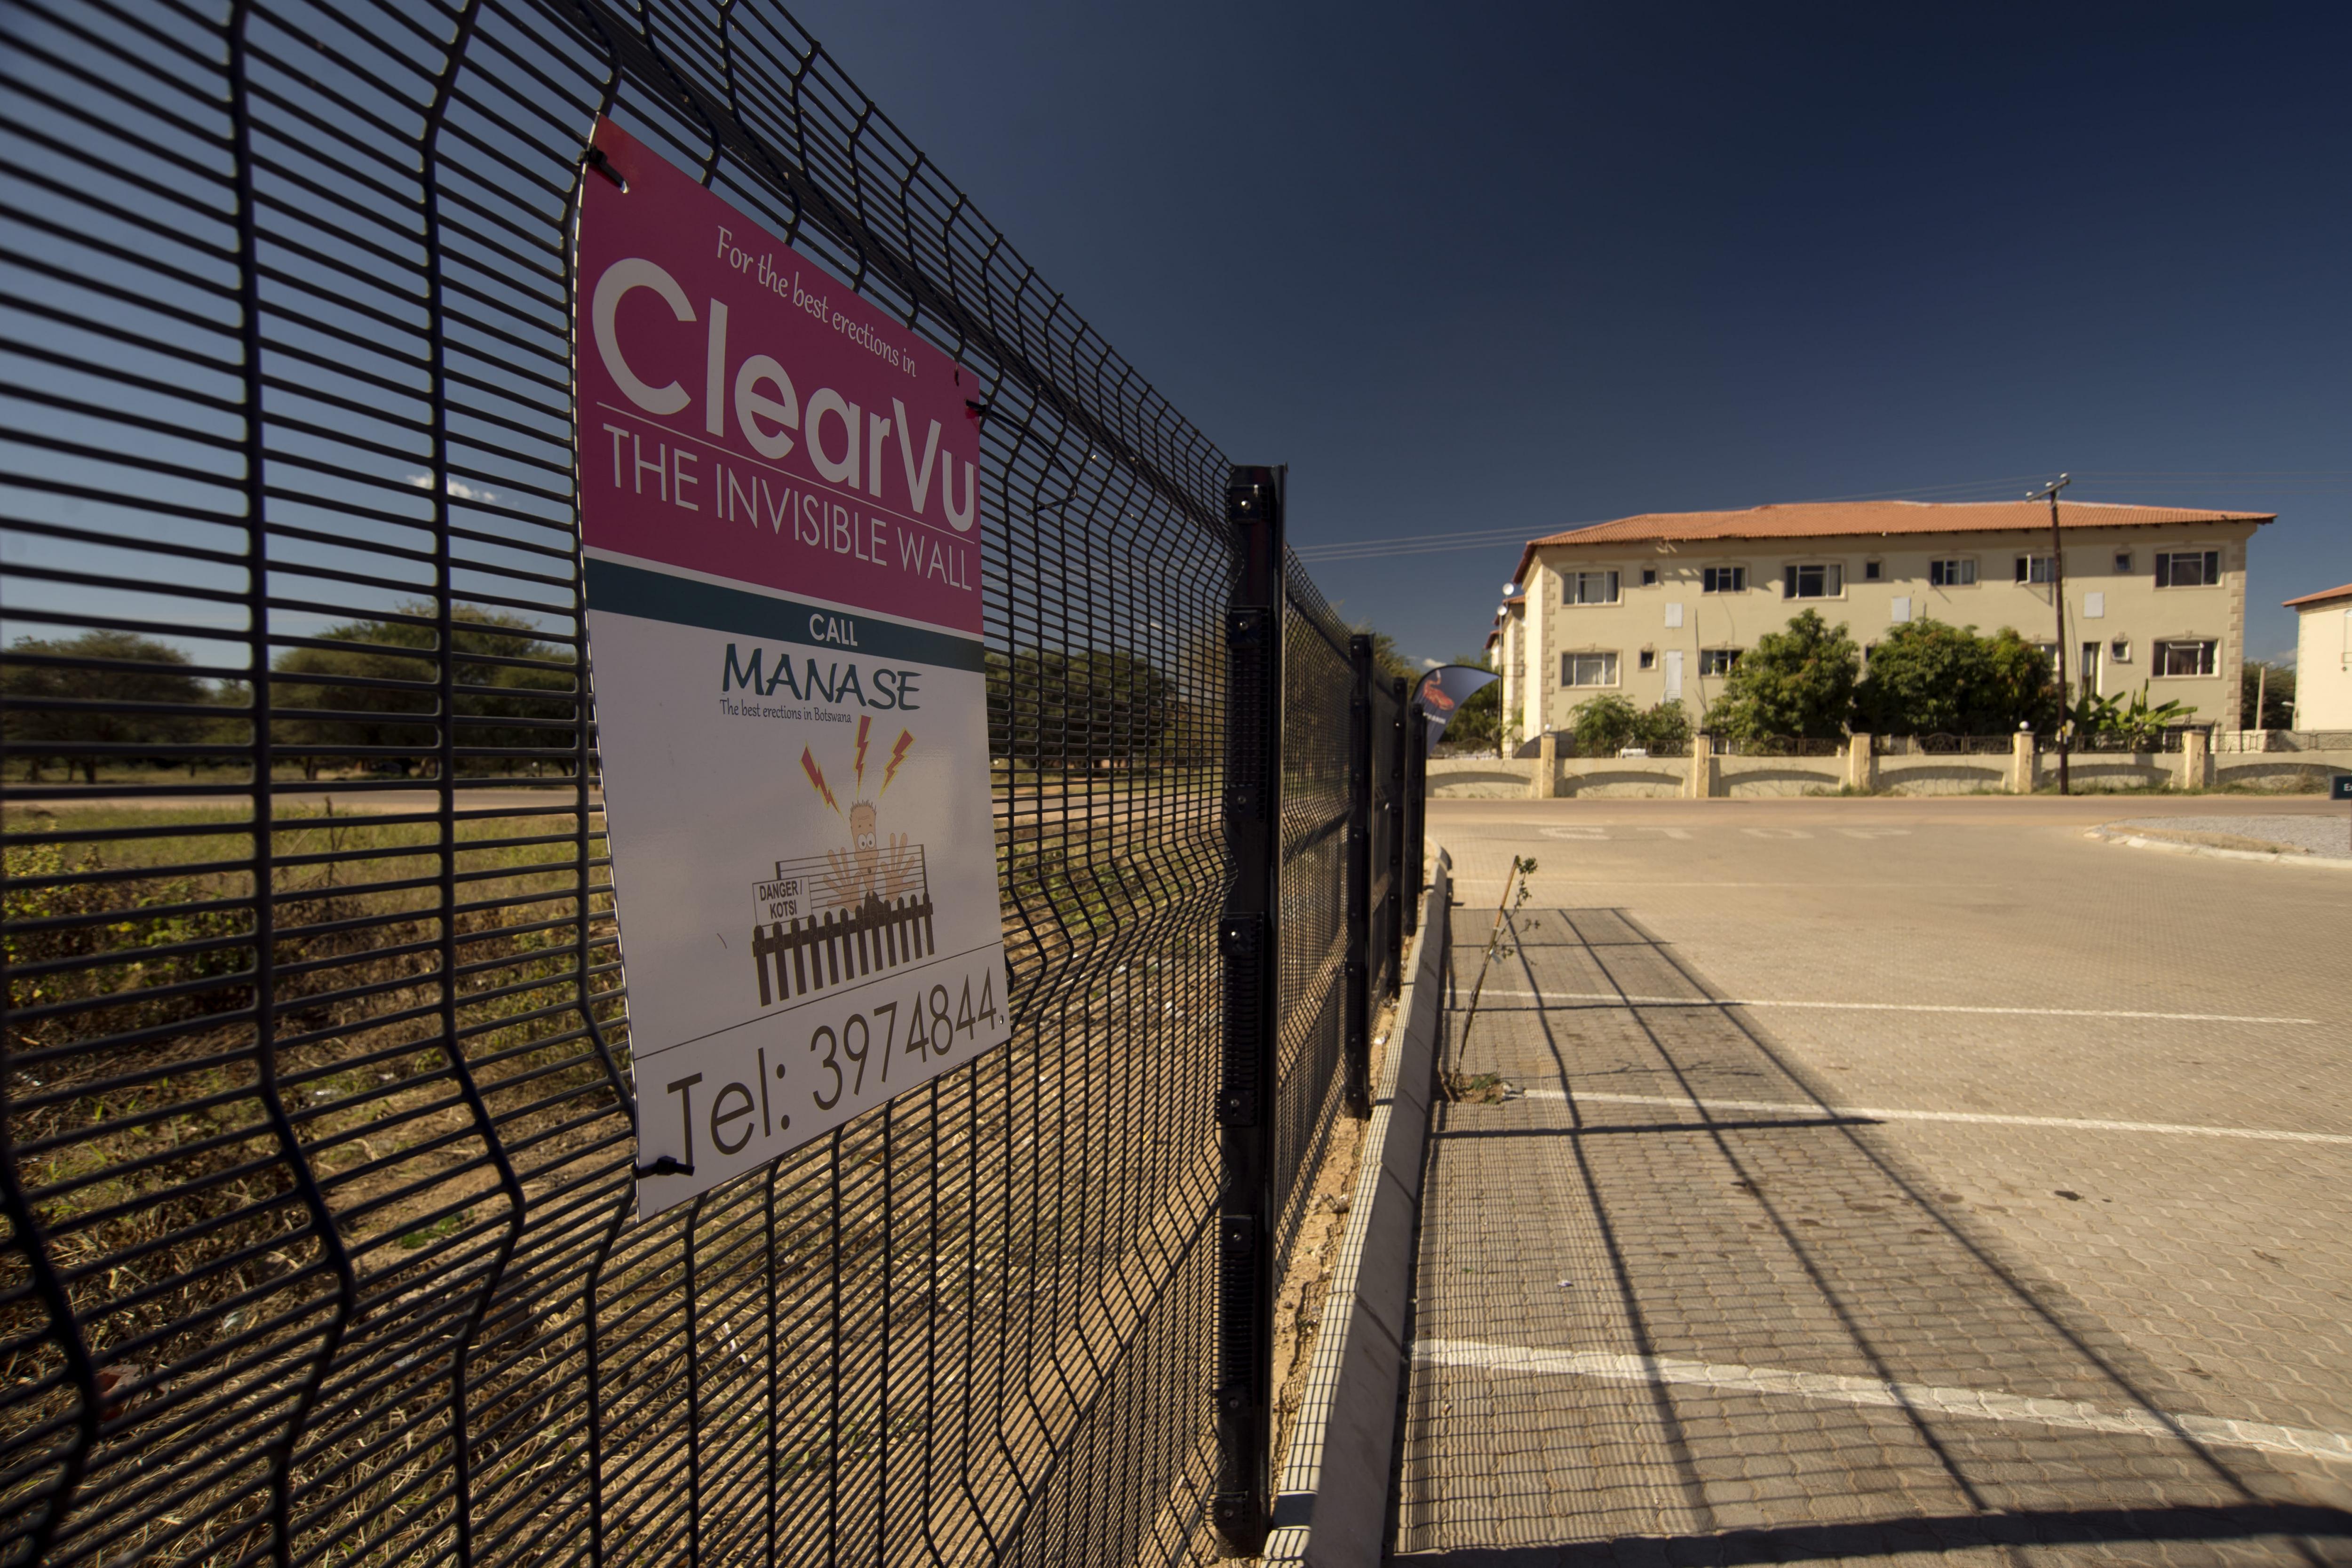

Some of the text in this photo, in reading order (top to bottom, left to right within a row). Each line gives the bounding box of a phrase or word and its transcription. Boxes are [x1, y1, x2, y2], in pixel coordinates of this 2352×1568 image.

[717, 225, 916, 378] For the best erections in
[592, 257, 975, 533] ClearVu
[603, 422, 972, 591] THE INVISIBLE WALL
[809, 613, 858, 646] CALL
[722, 643, 922, 710] MANASE
[719, 698, 852, 723] The best erections in Botswana
[759, 880, 799, 901] DANGER
[770, 899, 797, 919] KOTSI
[667, 967, 997, 1166] Tel: 3974844
